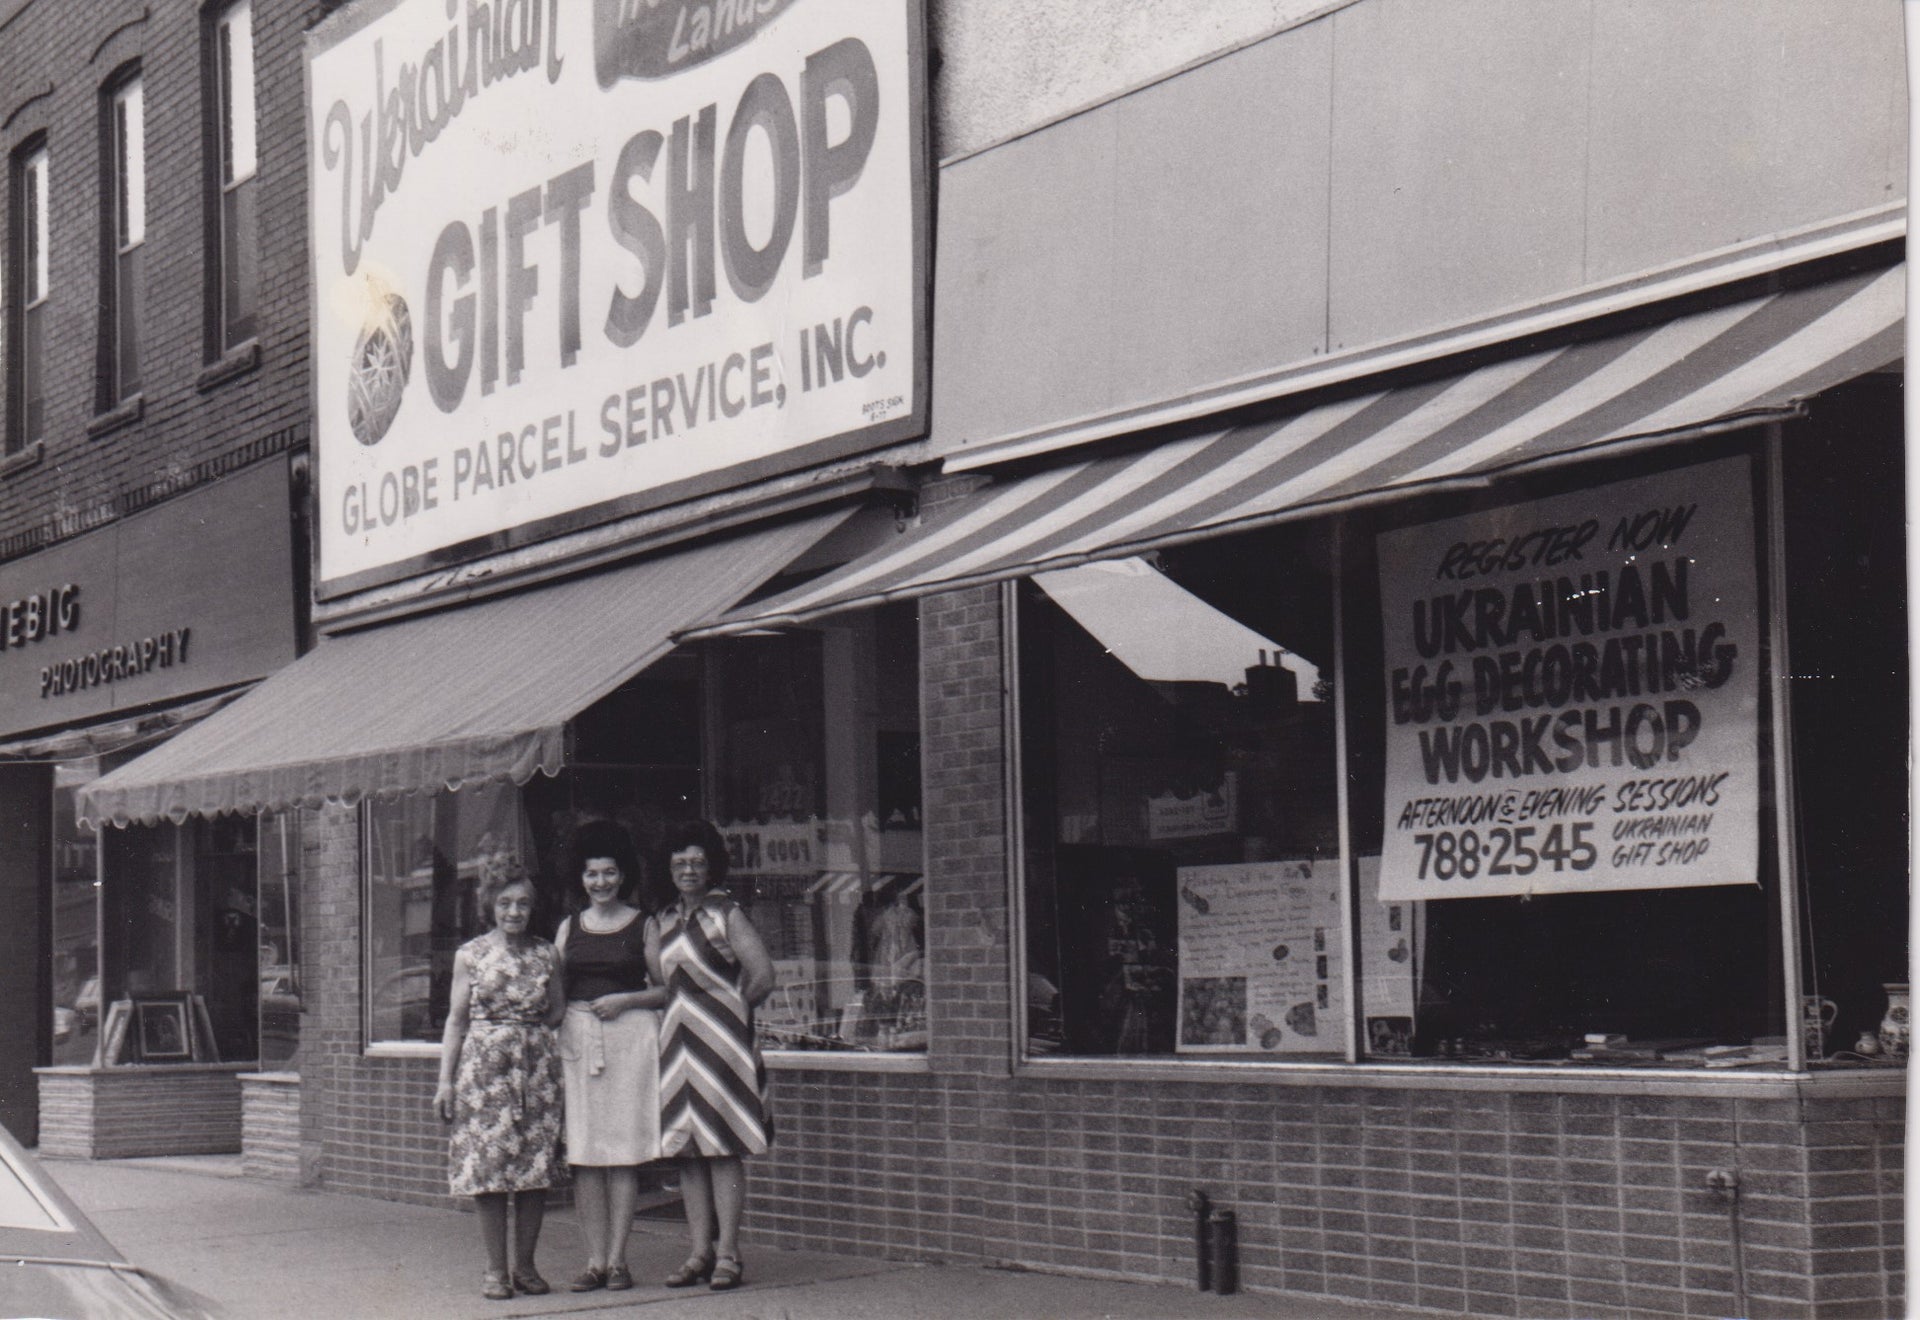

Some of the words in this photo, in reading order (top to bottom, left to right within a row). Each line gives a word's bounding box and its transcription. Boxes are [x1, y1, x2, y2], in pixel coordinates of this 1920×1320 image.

[323, 0, 564, 276] Ukrainian
[423, 159, 595, 414] GIFT
[604, 37, 880, 348] SHOP
[341, 458, 438, 535] GLOBE
[452, 408, 587, 501] PARCEL
[599, 342, 786, 459] SERVICE,
[800, 305, 886, 392] INC.
[1437, 519, 1599, 580] REGISTER
[1608, 503, 1698, 551] NOW
[1412, 556, 1690, 658] UKRAINIAN
[40, 627, 191, 698] PHOTOGRAPHY
[1392, 660, 1463, 725] EGG
[1472, 622, 1738, 716] DECORATING
[1419, 700, 1702, 786] WORKSHOP
[1397, 795, 1500, 830] AFTERNOON
[1499, 789, 1521, 824] &
[1518, 784, 1606, 820] EVENING
[1612, 772, 1730, 813] SESSIONS
[1612, 813, 1715, 841] UKRAINIAN
[1611, 843, 1652, 868] GIFT
[1655, 836, 1711, 866] SHOP
